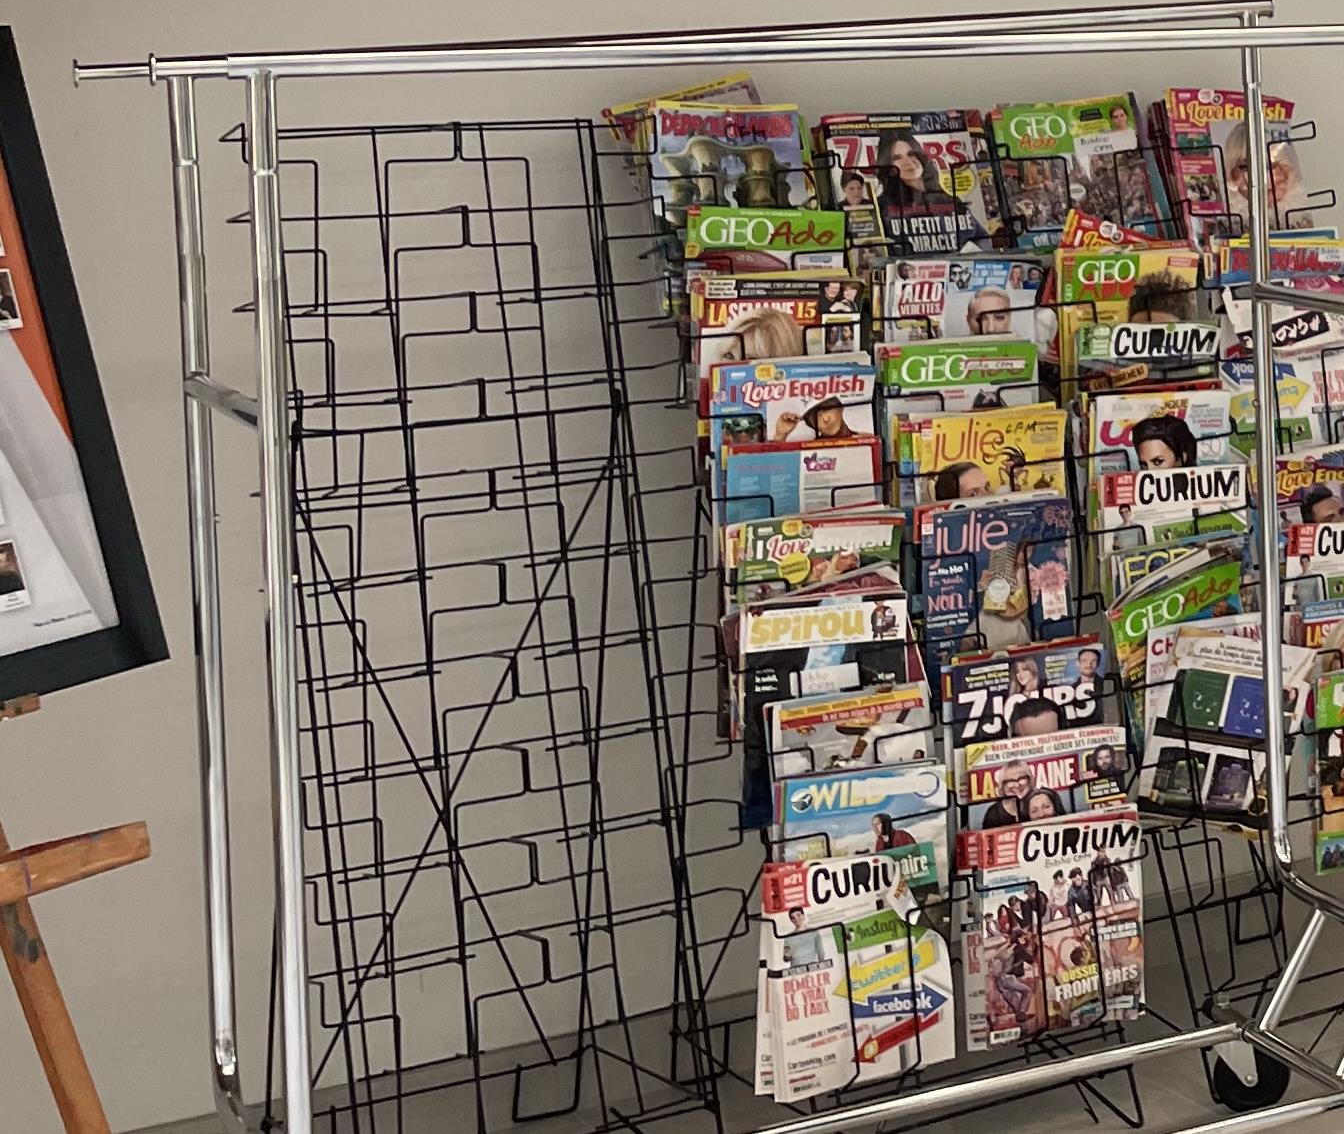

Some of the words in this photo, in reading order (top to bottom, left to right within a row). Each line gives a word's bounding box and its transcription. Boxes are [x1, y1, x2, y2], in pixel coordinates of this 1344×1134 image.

[1224, 100, 1288, 122] Enish
[1009, 114, 1067, 141] GEO
[699, 215, 776, 246] GEO
[1077, 258, 1137, 285] GEO
[902, 281, 943, 304] ALLO
[741, 380, 787, 409] Love
[788, 373, 866, 400] English
[767, 534, 813, 564] Love
[1125, 593, 1186, 638] GEO
